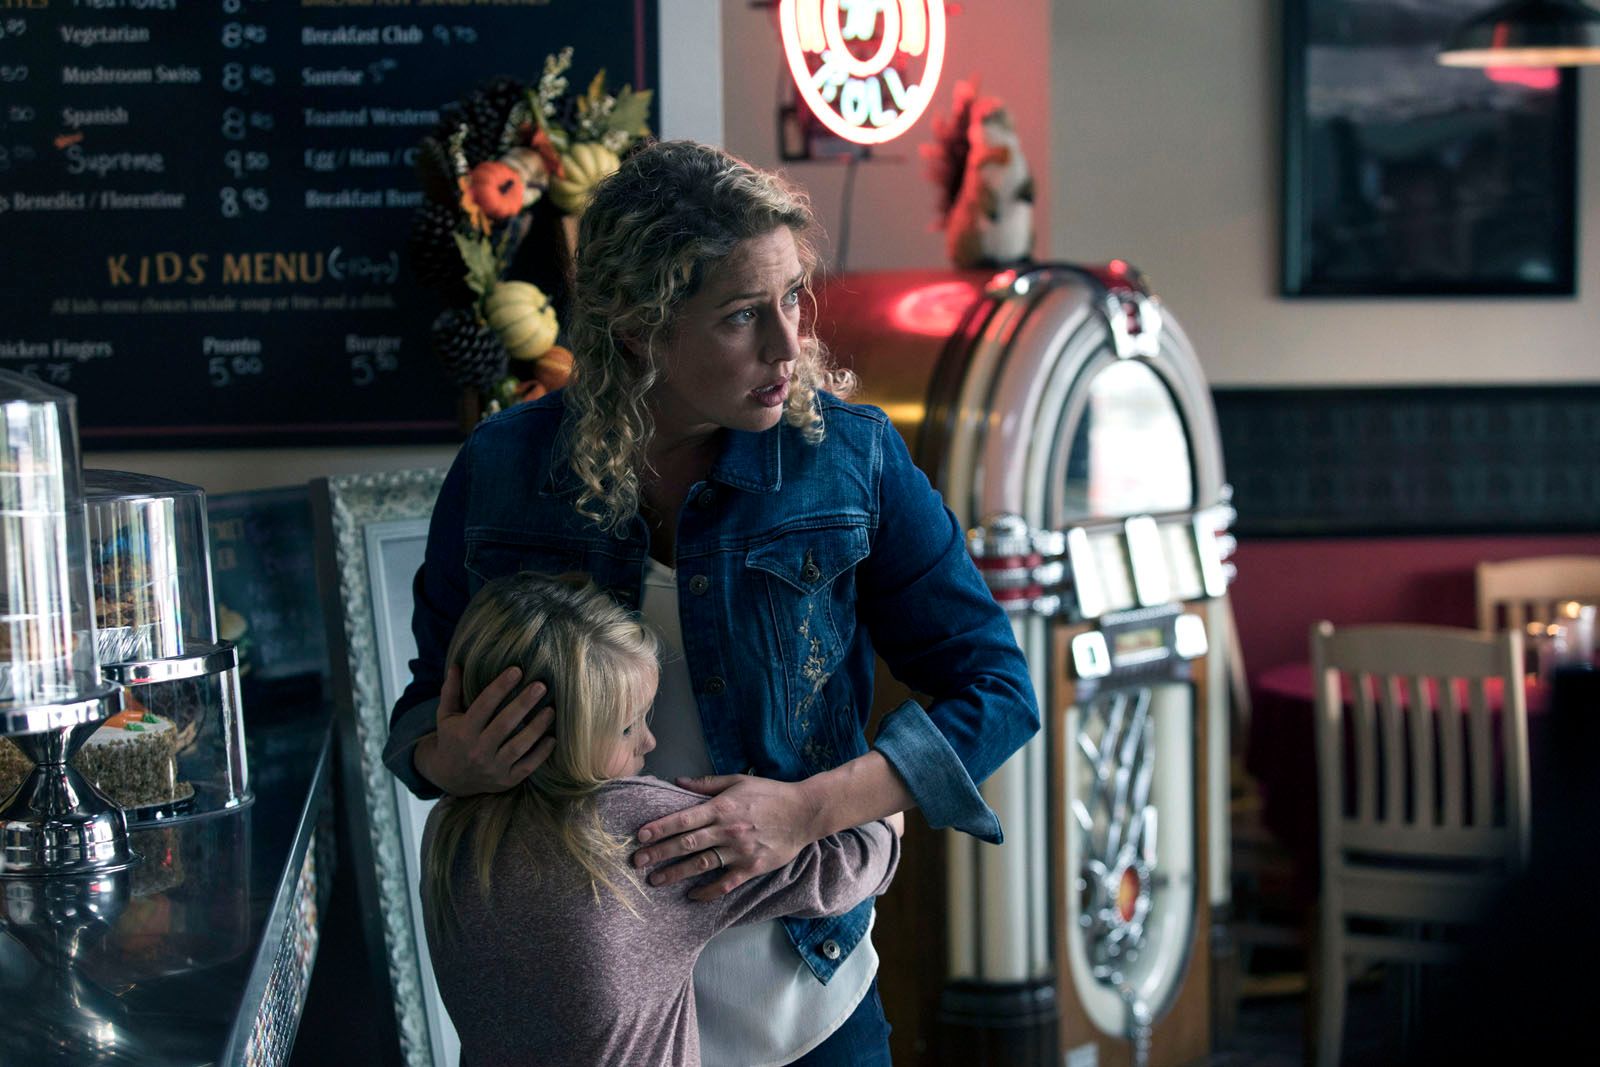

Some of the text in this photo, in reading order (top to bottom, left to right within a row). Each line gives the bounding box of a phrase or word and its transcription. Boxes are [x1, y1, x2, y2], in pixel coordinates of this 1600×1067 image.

[60, 25, 150, 47] Vegetarian
[301, 25, 379, 45] Breakfast
[381, 24, 423, 45] Club
[62, 66, 152, 84] Mushroom
[155, 66, 201, 83] Swiss
[302, 67, 364, 86] Sunrise
[62, 106, 129, 129] Spanish
[304, 108, 441, 126] Toasted Western
[67, 145, 165, 176] Supreme
[304, 150, 337, 171] Egg
[350, 150, 390, 167] Ham
[14, 194, 85, 210] Benedict
[100, 192, 185, 209] Florentine
[305, 190, 384, 208] Breakfast
[107, 252, 209, 287] KIDS
[222, 251, 324, 285] MENU
[0, 338, 114, 362] icken Fingers
[346, 334, 402, 357] Burger
